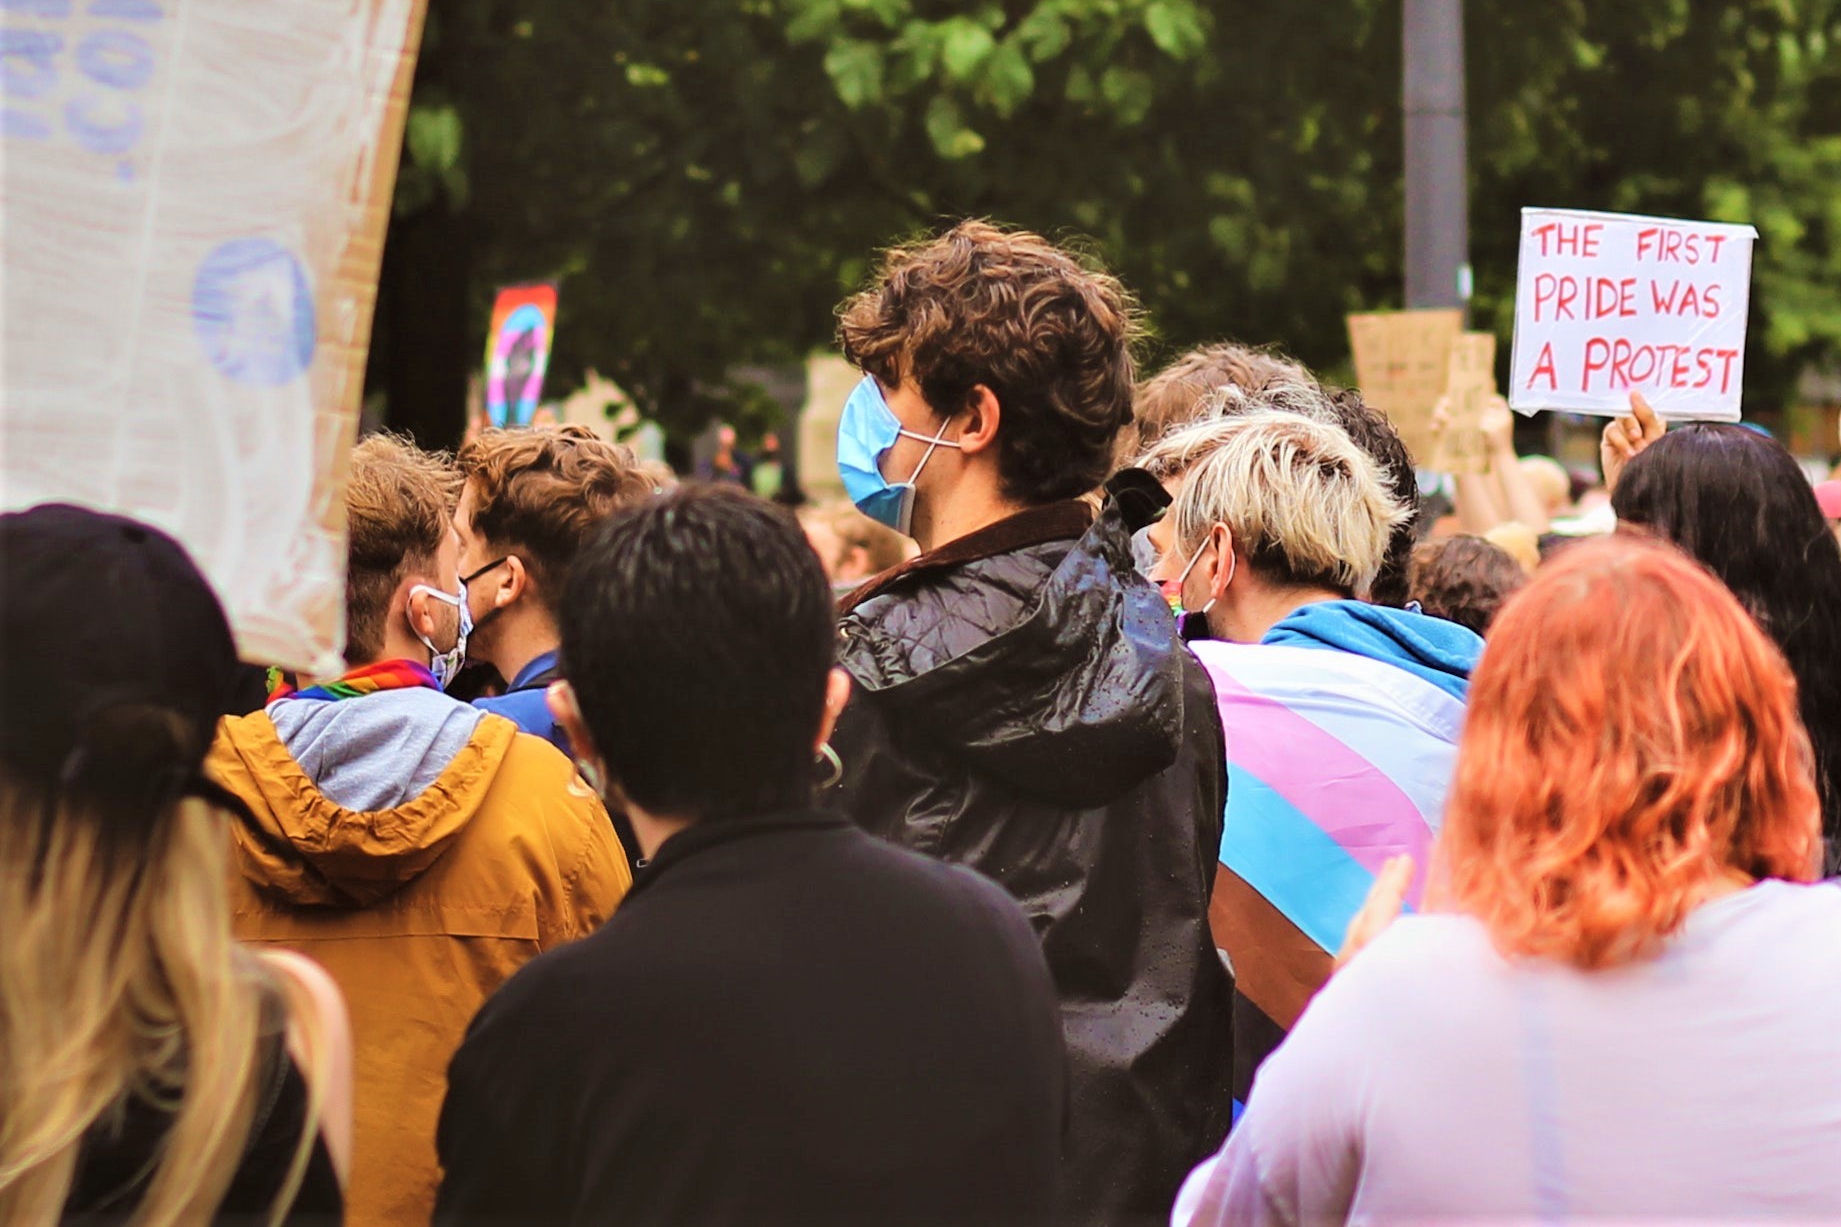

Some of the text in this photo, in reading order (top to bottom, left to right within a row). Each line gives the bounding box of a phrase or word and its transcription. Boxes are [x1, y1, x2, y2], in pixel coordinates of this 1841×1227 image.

[1531, 223, 1727, 264] THE FIRST
[1534, 273, 1721, 321] PRIDE WAS
[1526, 337, 1738, 394] A PROTEST
